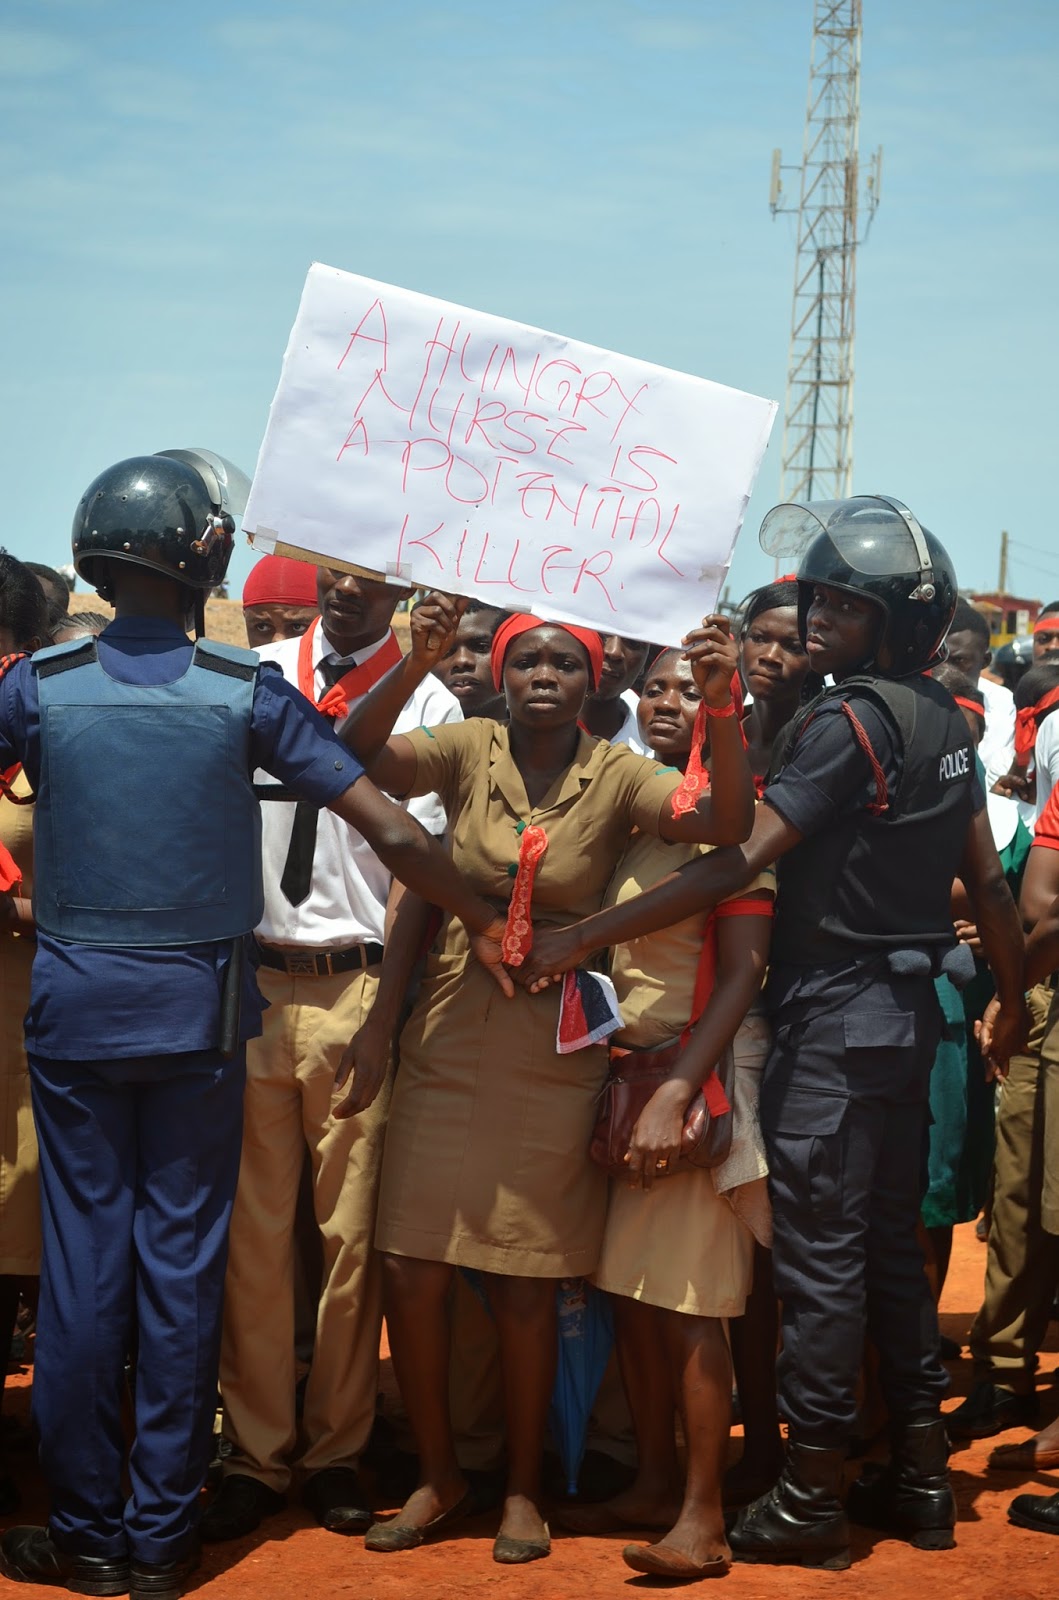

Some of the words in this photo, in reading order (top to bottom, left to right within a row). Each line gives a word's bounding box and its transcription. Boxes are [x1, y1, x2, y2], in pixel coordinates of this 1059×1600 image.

[337, 298, 390, 372] A
[420, 317, 649, 443] HUNGRY
[354, 368, 588, 465] NURSE
[606, 445, 678, 492] IS
[336, 417, 371, 462] A
[401, 438, 684, 577] POTENTIAL
[396, 513, 624, 612] KILLER.
[939, 747, 969, 781] POLICE
